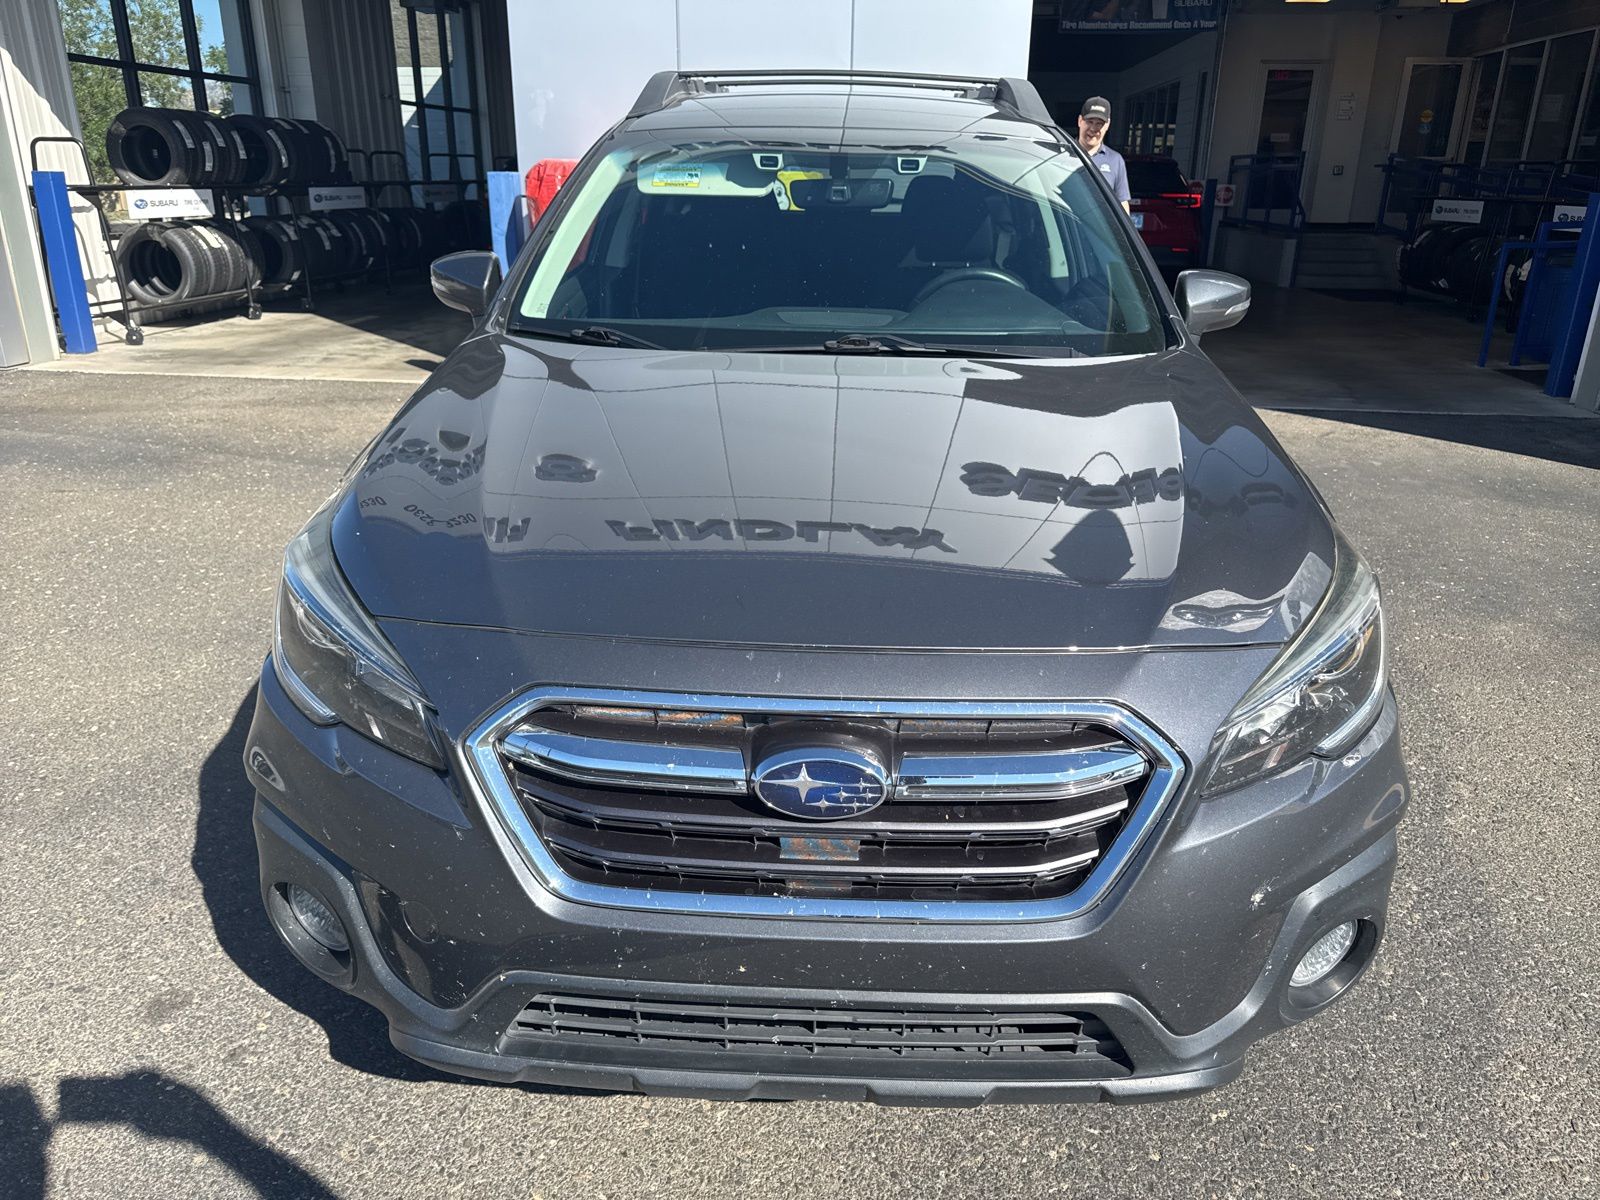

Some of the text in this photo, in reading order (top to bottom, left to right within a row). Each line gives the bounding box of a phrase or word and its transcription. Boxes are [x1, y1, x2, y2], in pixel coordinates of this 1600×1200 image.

[1062, 20, 1077, 29] Tire
[1129, 20, 1173, 29] Recommend
[1174, 20, 1192, 29] Once
[1193, 20, 1199, 28] A
[150, 199, 179, 207] SUBARU
